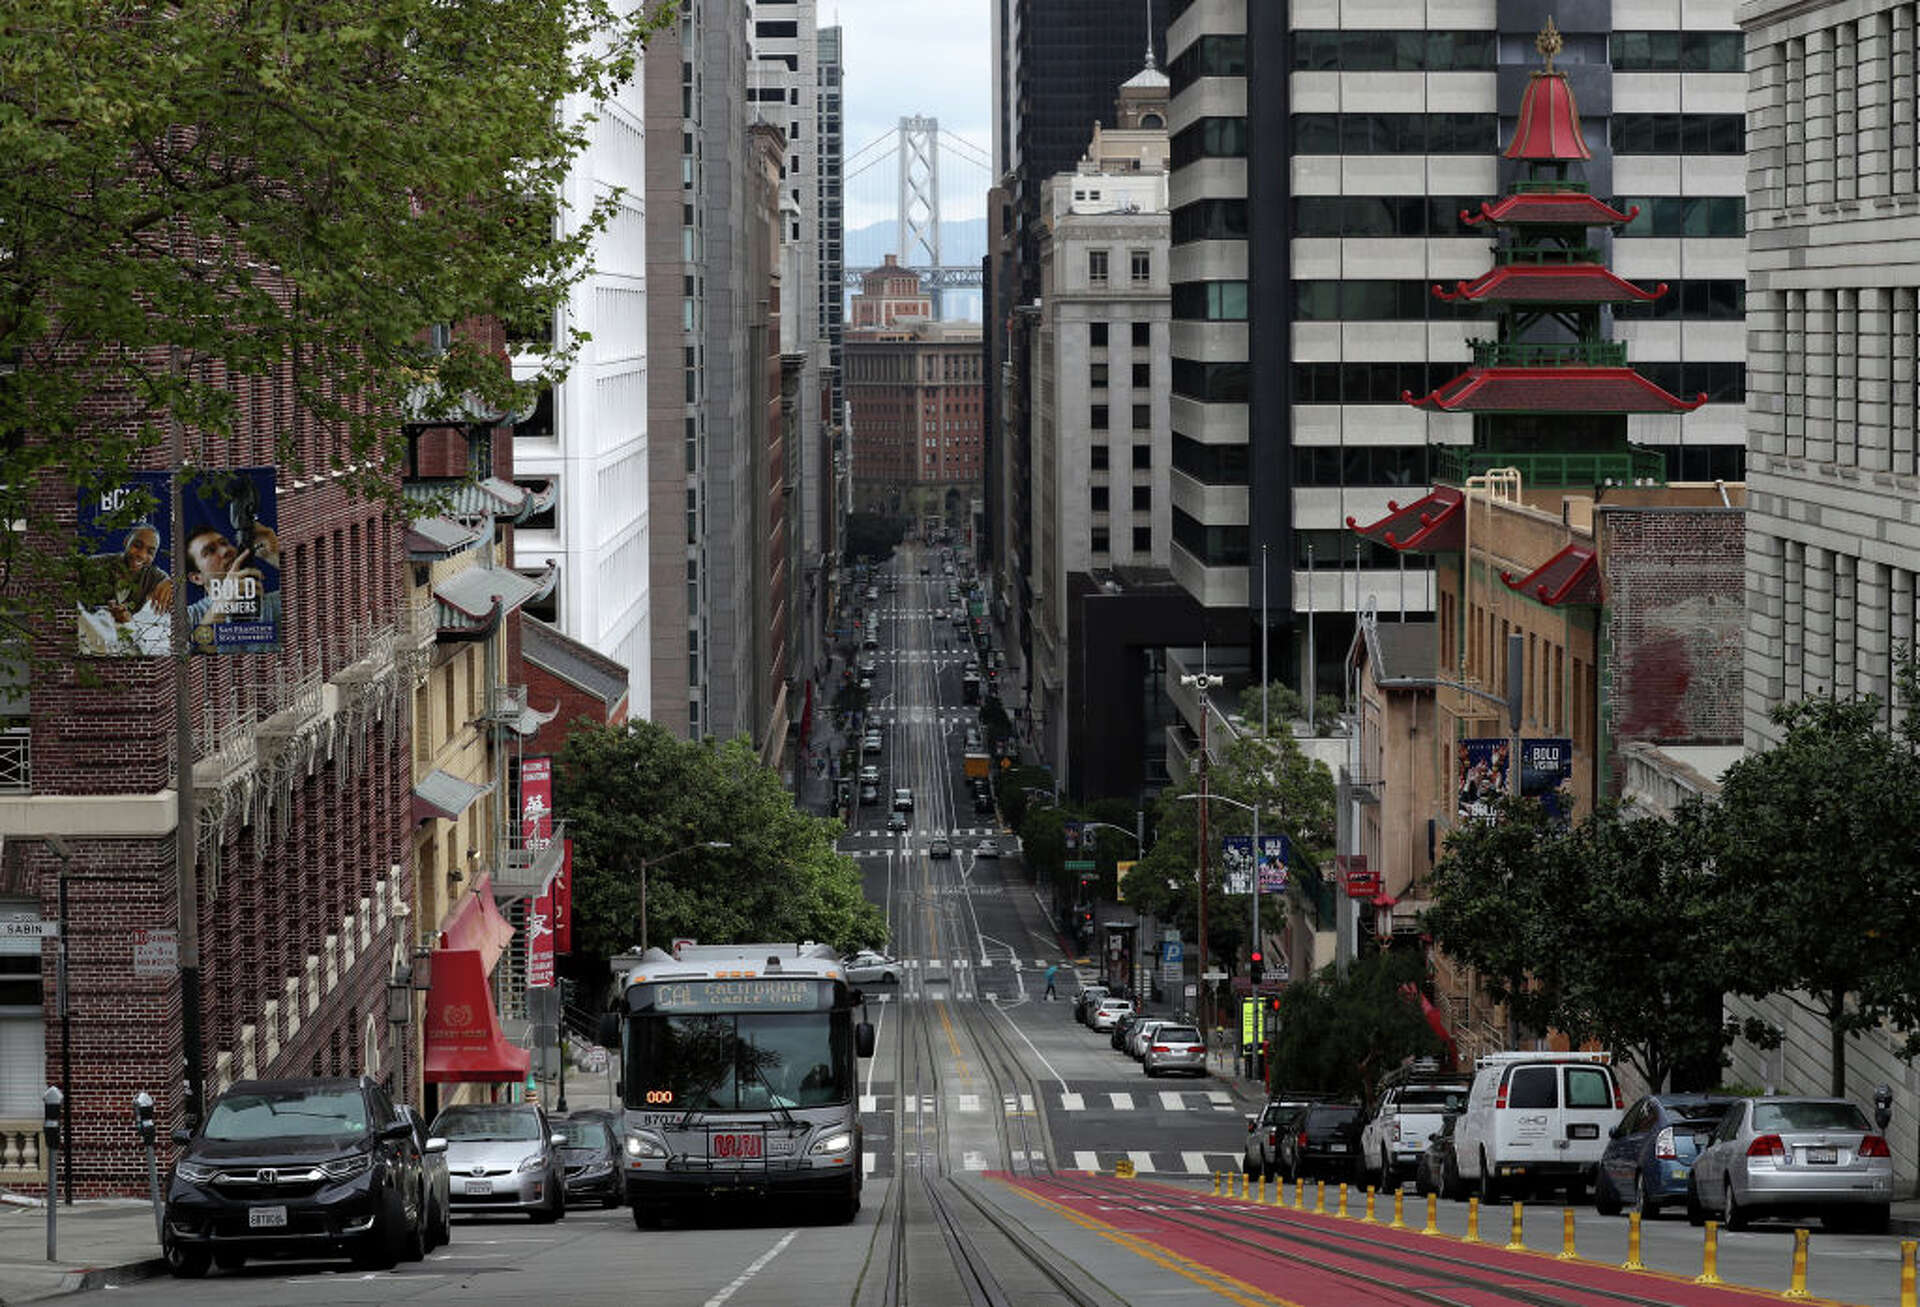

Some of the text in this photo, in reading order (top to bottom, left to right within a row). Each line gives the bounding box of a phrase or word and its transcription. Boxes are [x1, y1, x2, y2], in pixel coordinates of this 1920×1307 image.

[211, 578, 256, 599] BOLD
[1533, 747, 1559, 760] BOLD
[7, 924, 42, 934] SABIN
[658, 985, 698, 1007] CAL
